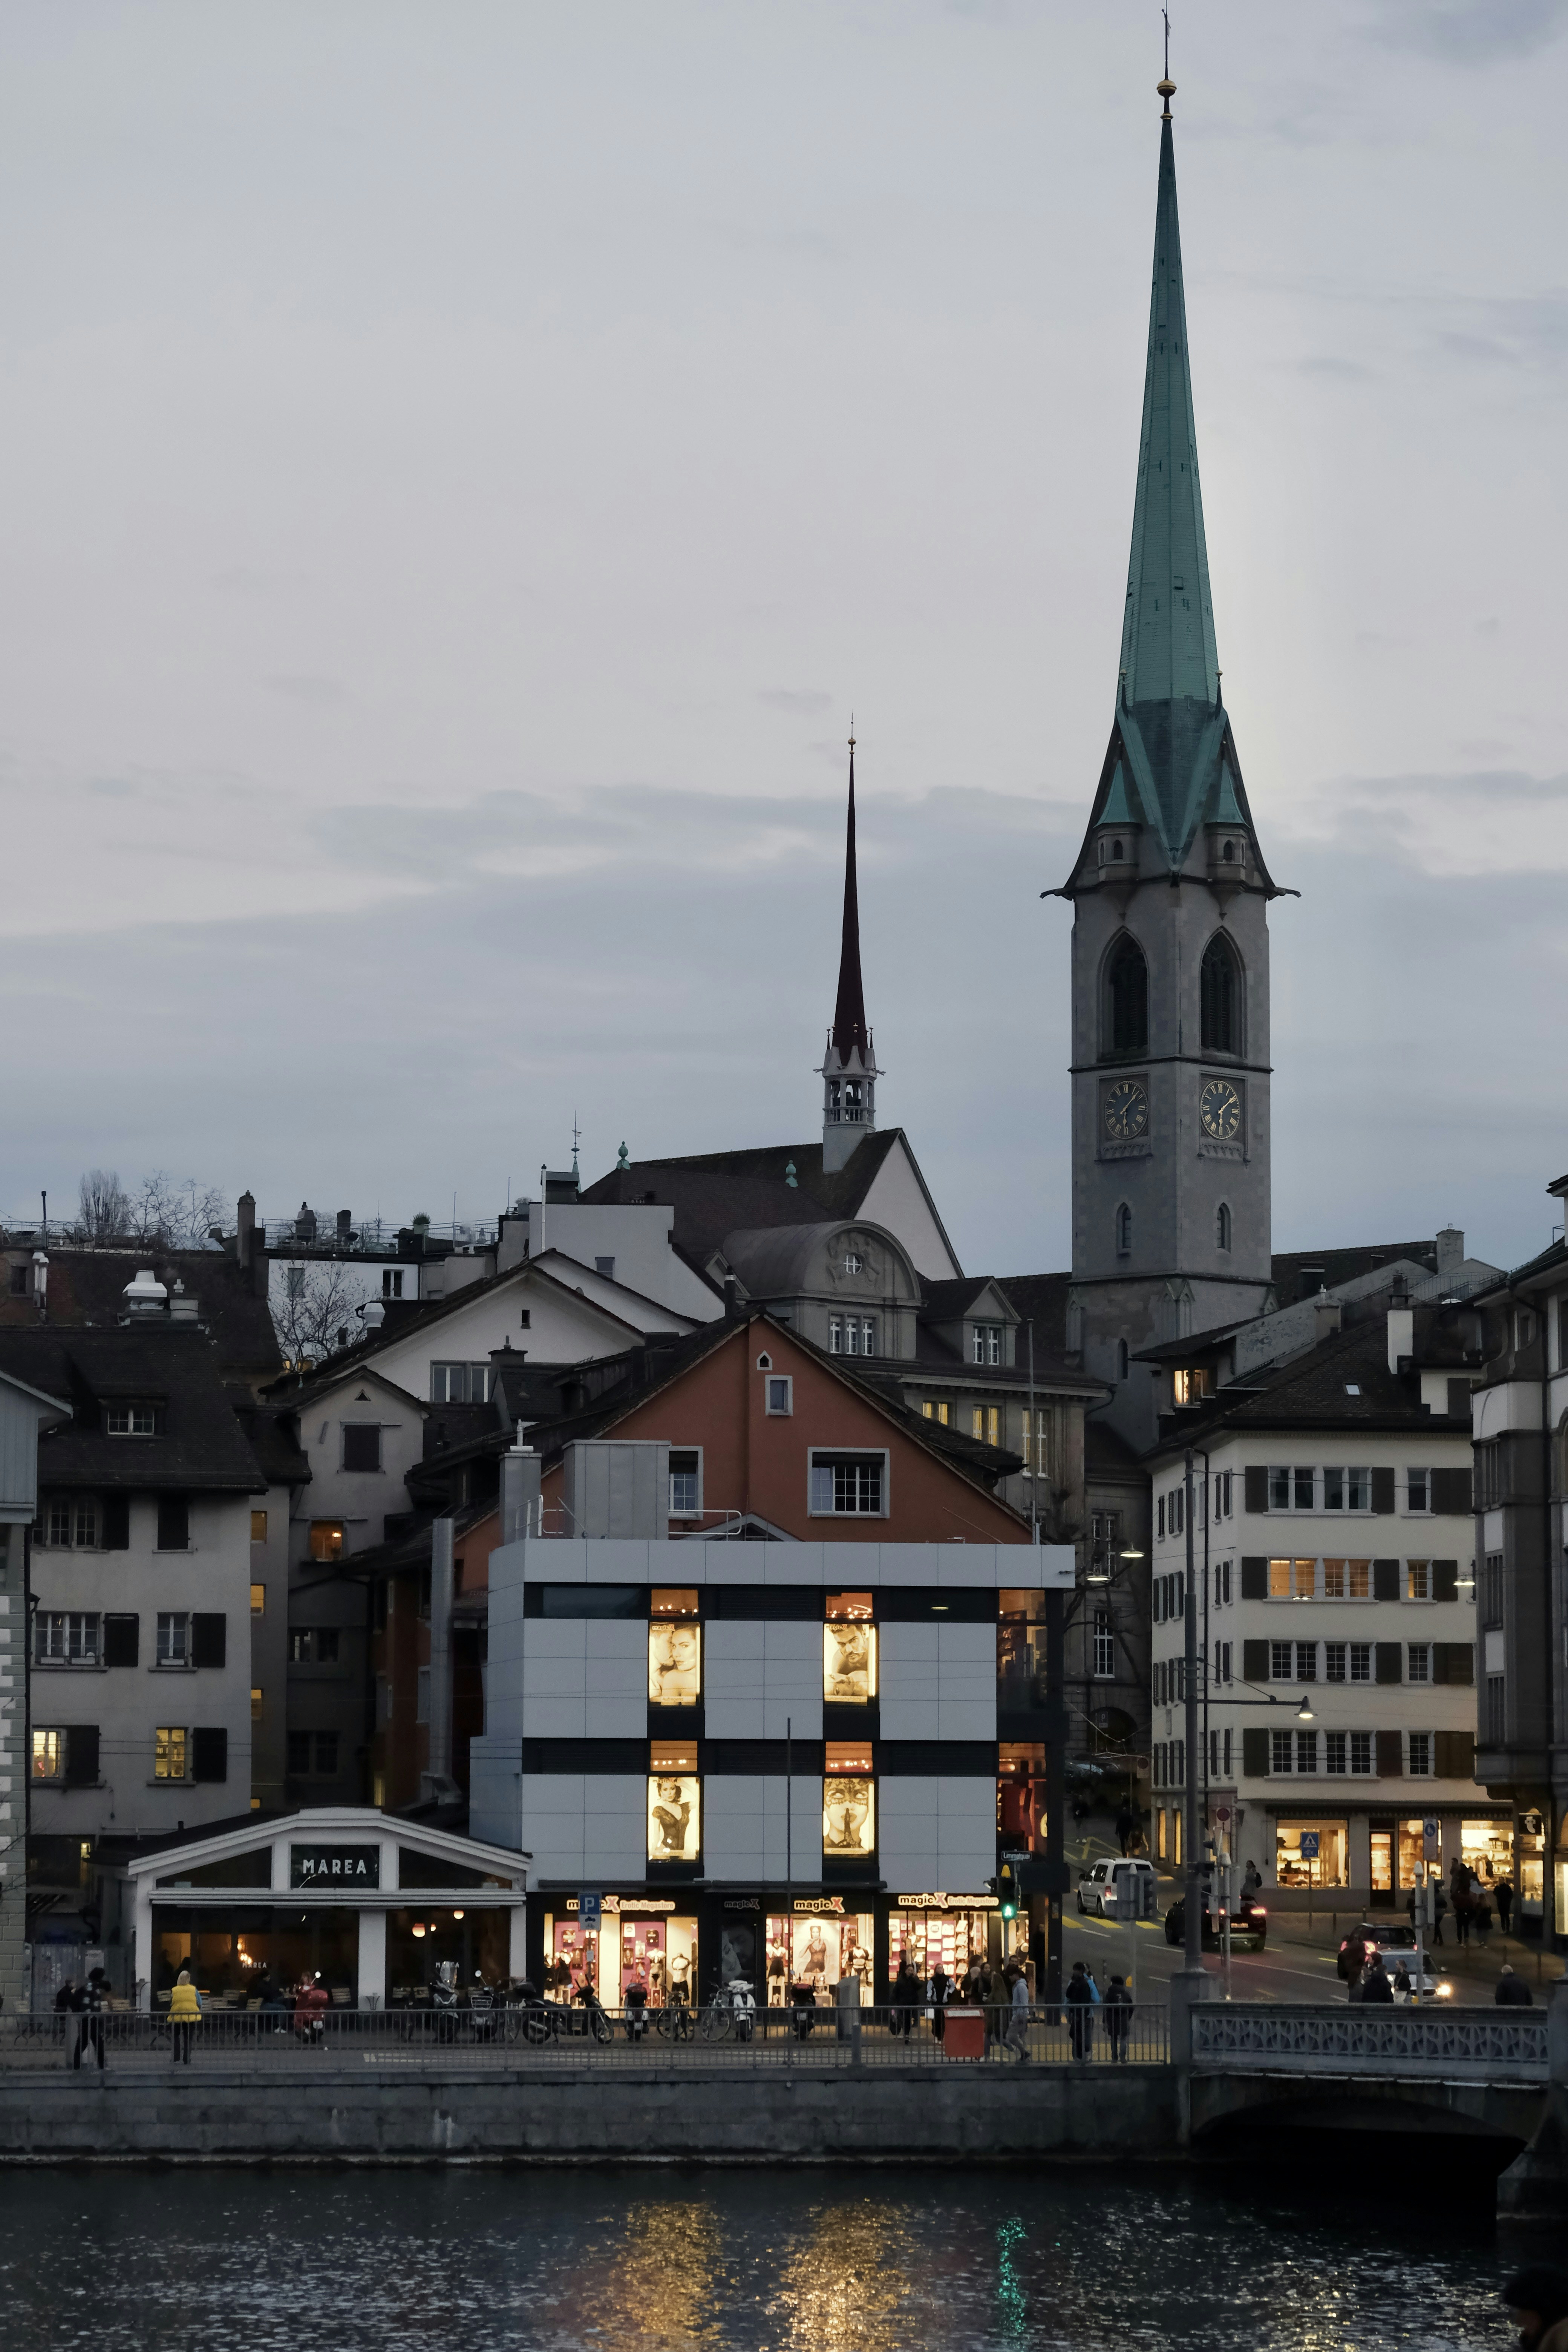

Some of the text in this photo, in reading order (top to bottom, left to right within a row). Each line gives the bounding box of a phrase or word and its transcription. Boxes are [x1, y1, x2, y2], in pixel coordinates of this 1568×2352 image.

[303, 1859, 366, 1874] MAREA
[585, 1897, 594, 1913] P
[622, 1901, 639, 1909] Erotic
[641, 1901, 674, 1911] Megastore
[949, 1896, 965, 1904] Erotic
[967, 1896, 997, 1906] Megastore
